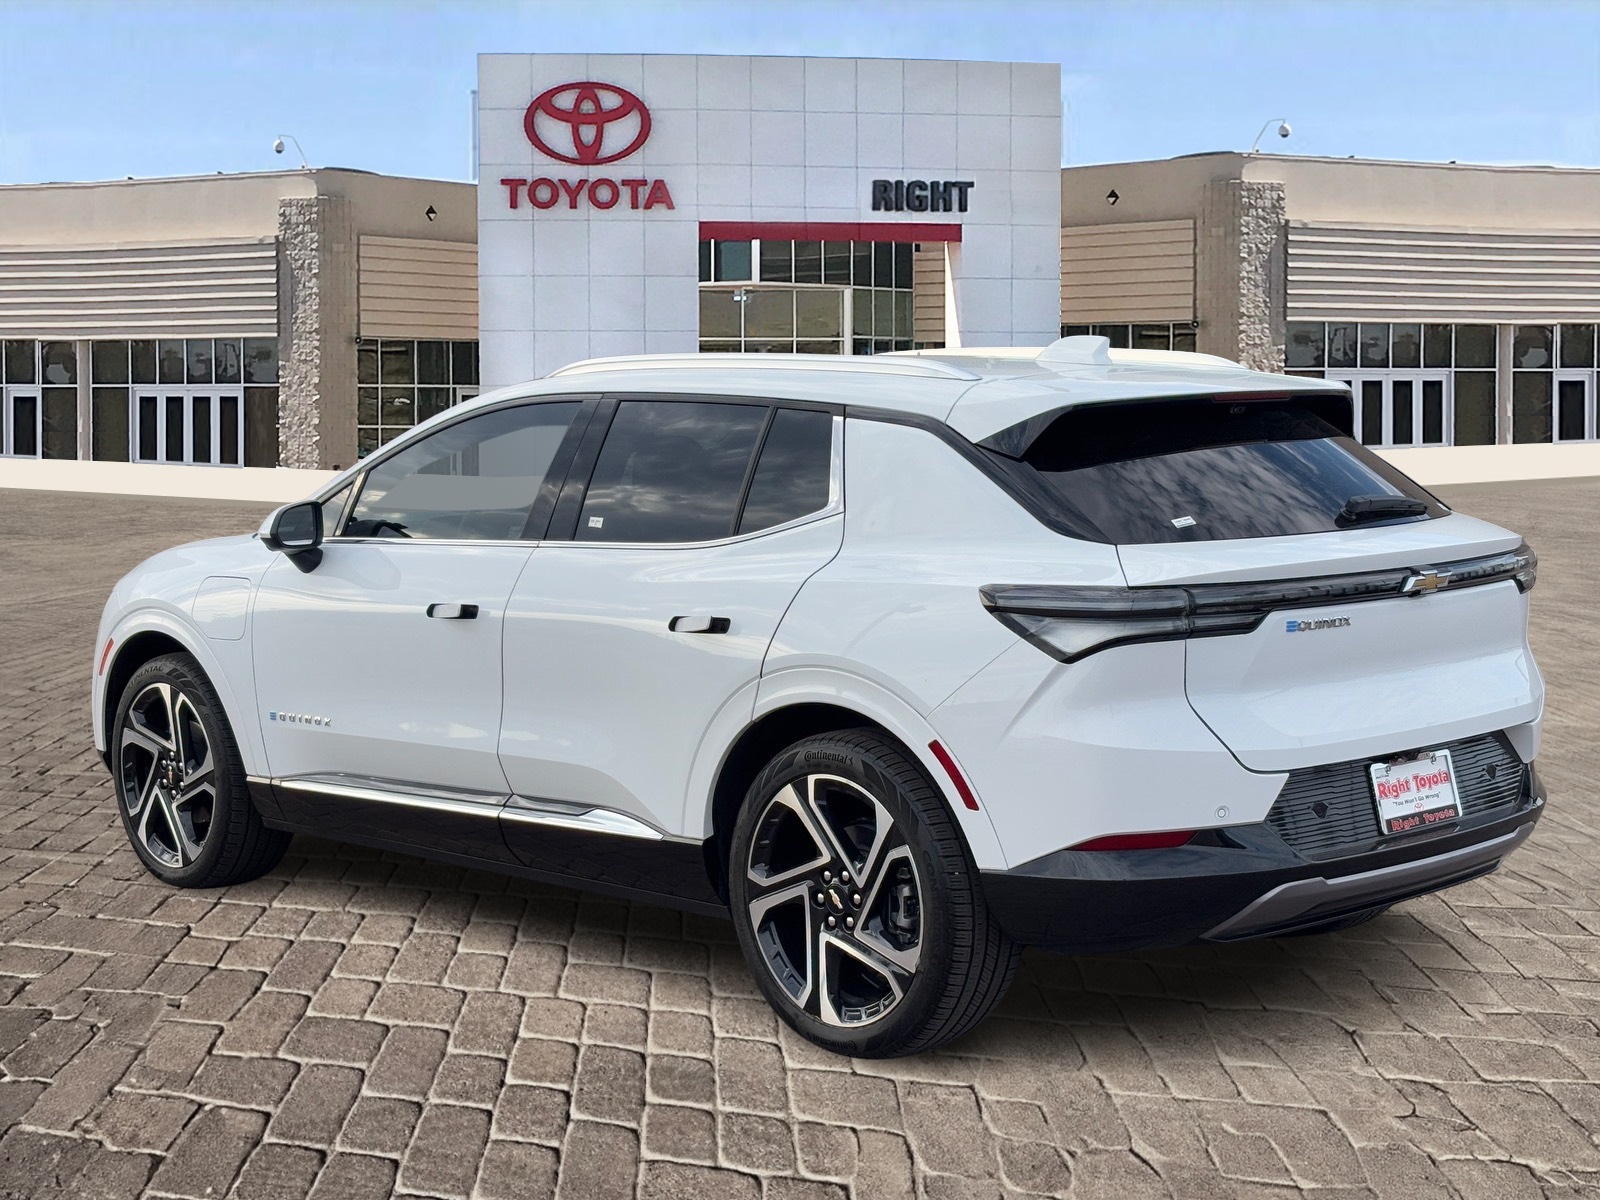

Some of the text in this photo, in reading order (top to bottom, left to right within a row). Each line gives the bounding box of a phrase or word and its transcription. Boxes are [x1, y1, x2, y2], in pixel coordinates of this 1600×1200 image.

[501, 177, 675, 211] TOYOTA
[872, 180, 975, 213] RIGHT
[1286, 616, 1351, 632] EQUINOX
[269, 711, 331, 727] EQUINOX
[804, 749, 848, 764] Continental
[1376, 770, 1450, 798] Right Toyota
[1391, 808, 1455, 831] Right Toyota
